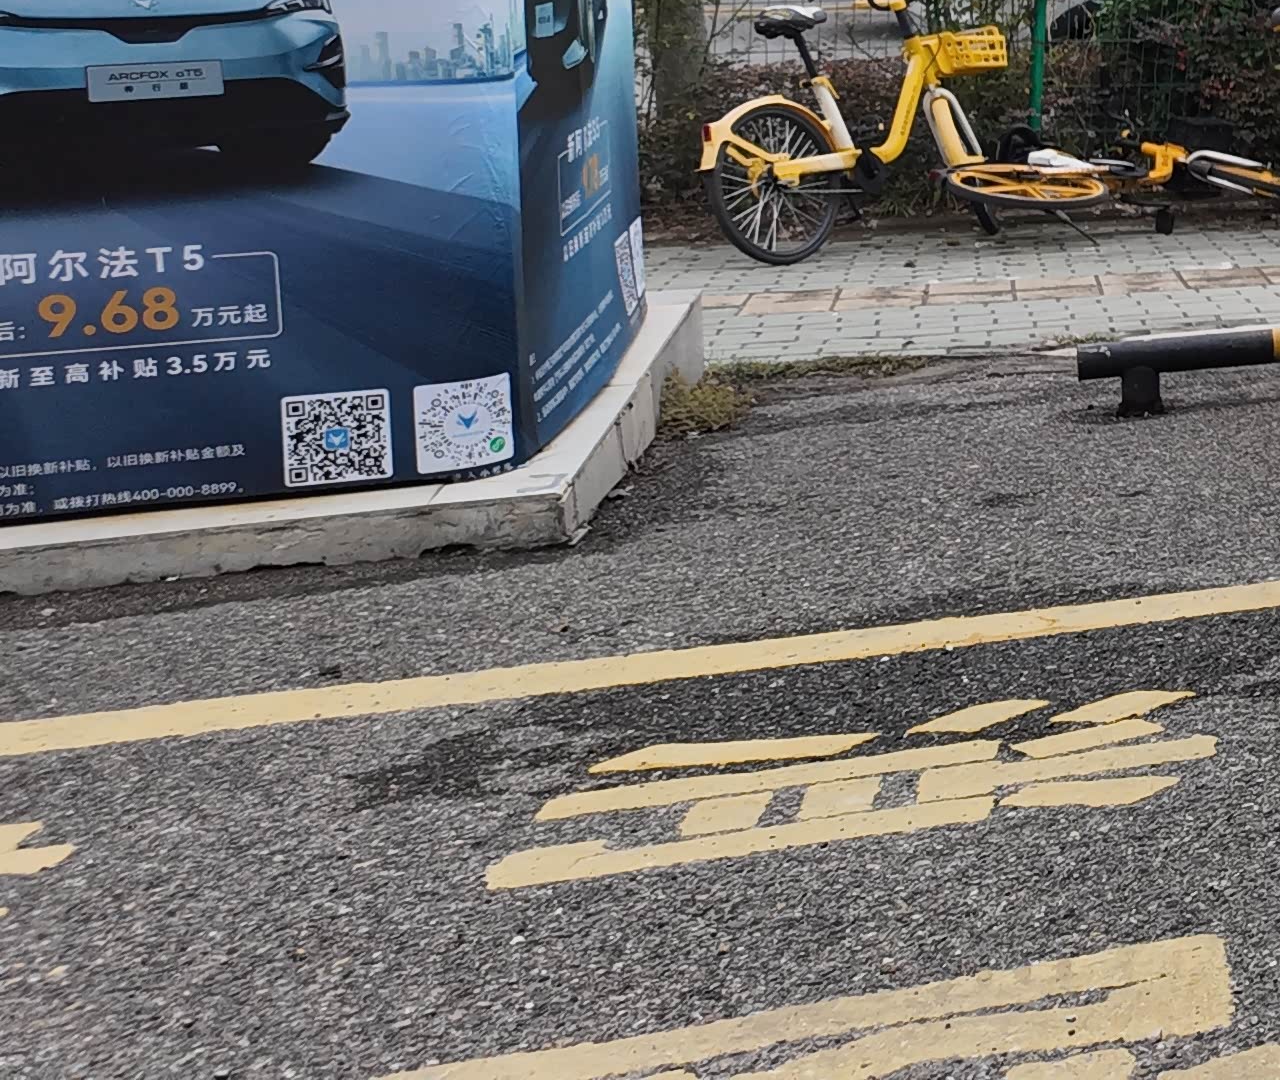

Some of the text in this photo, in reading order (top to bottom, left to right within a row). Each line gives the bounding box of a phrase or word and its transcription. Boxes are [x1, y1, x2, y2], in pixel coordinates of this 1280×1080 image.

[108, 71, 169, 81] ARCFOX
[38, 286, 180, 339] 9.68
[191, 303, 268, 327] 万元起
